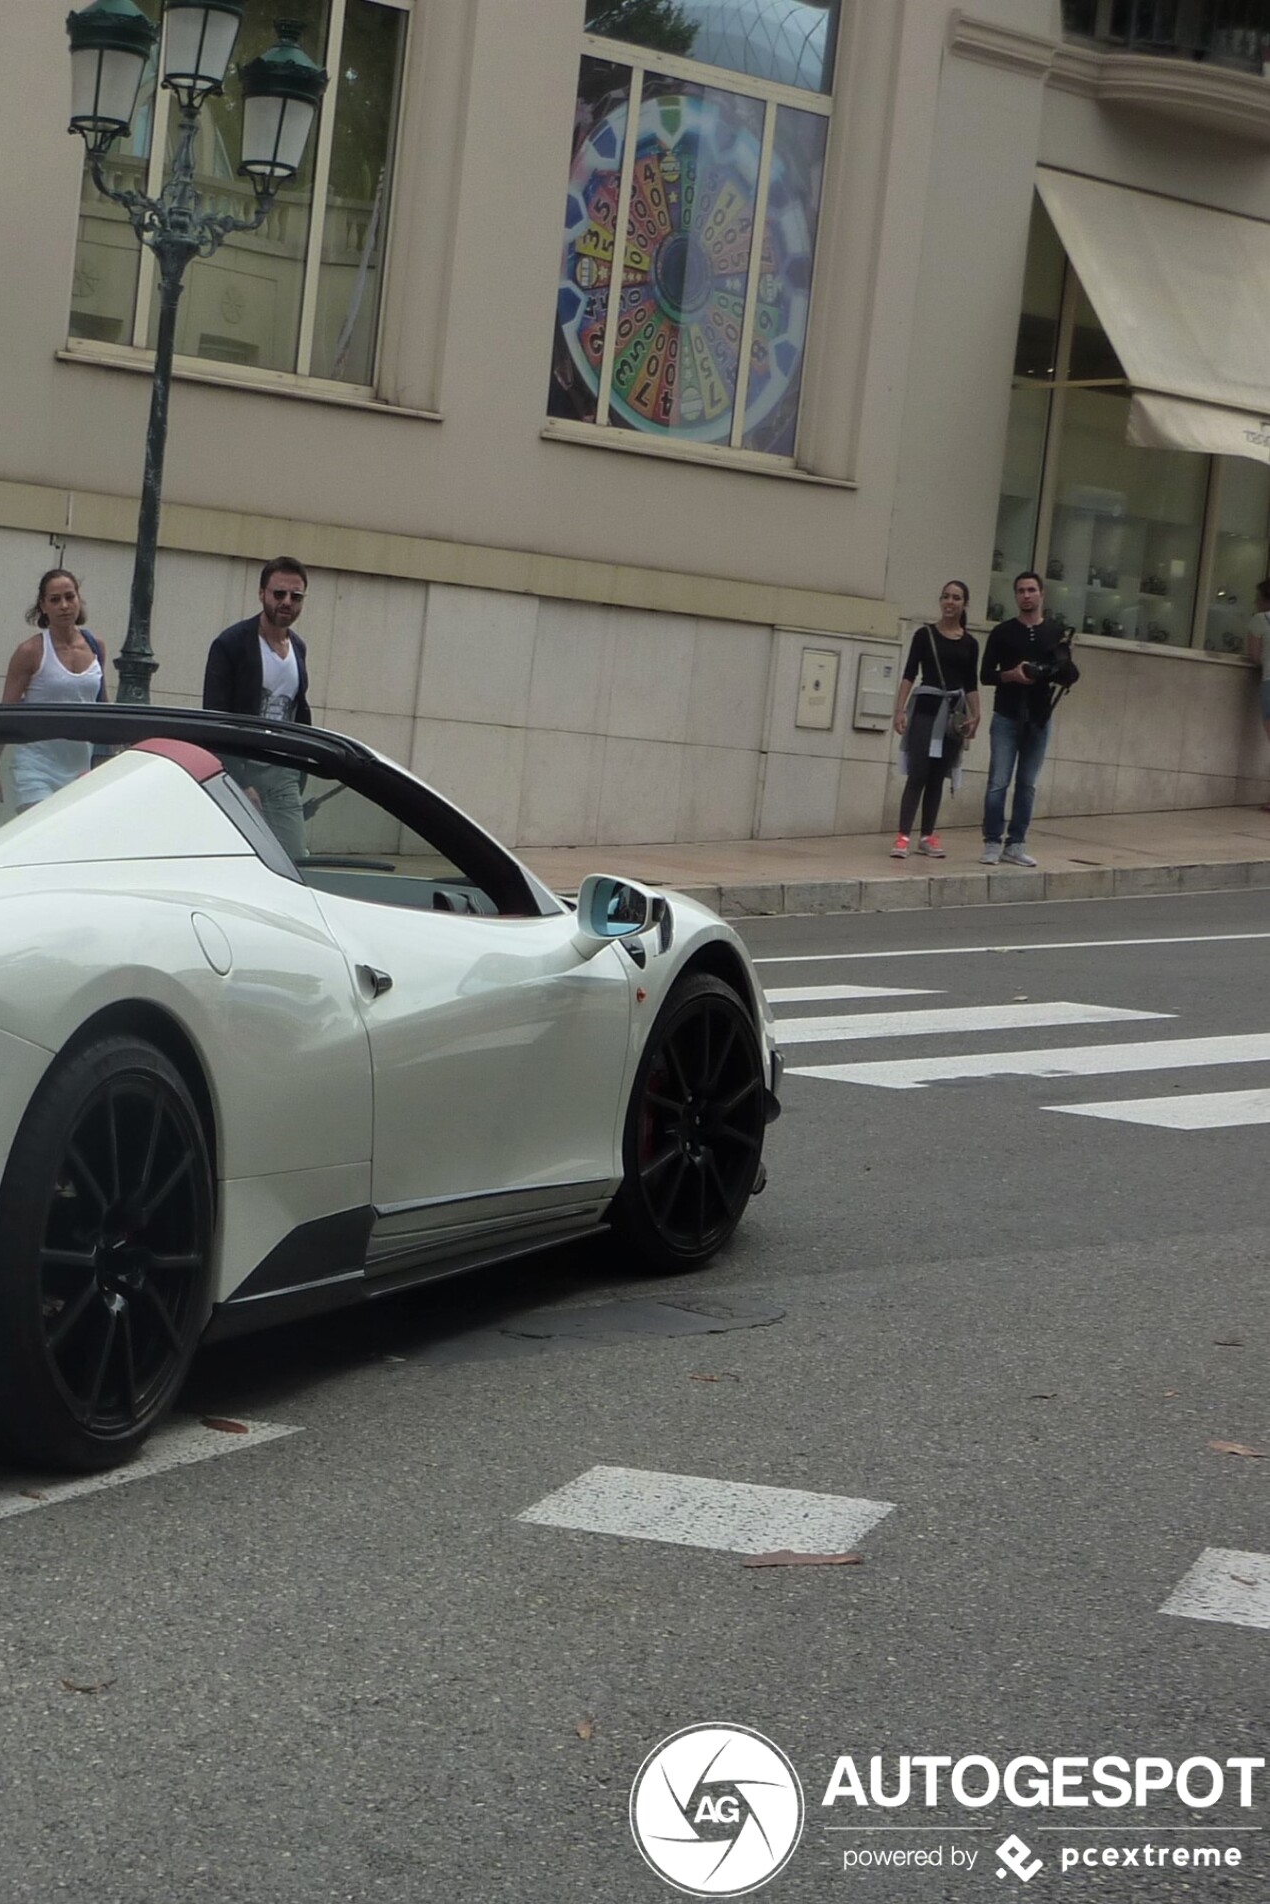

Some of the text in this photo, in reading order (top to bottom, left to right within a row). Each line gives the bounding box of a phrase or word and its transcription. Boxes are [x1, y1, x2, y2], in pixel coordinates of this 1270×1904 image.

[644, 163, 667, 227] 400
[616, 323, 655, 386] 350
[635, 333, 665, 408] 700
[661, 340, 677, 417] 400
[694, 336, 722, 409] 750
